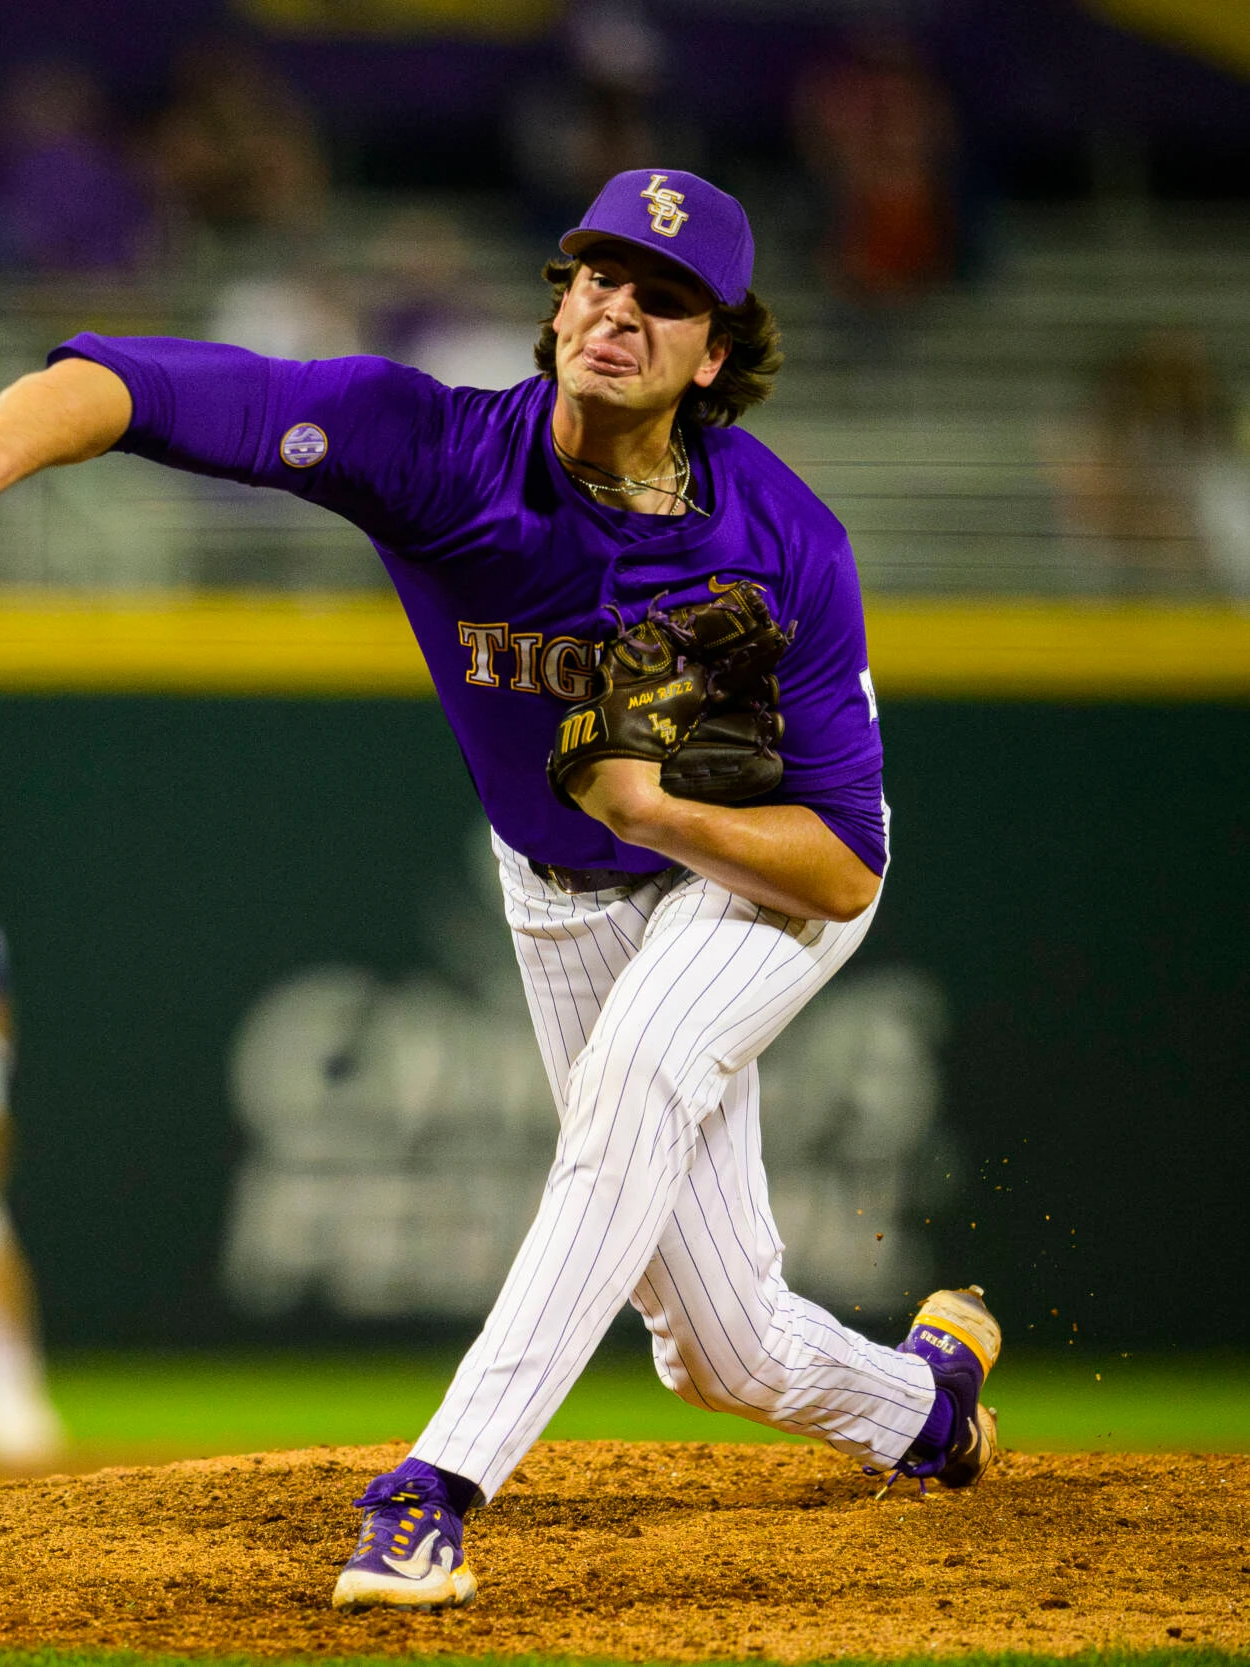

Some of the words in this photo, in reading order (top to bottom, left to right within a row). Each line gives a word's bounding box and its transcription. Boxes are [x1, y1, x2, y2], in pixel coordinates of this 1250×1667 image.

[640, 174, 689, 238] LSU
[457, 620, 604, 701] TIG
[920, 1330, 957, 1355] TIGERS
